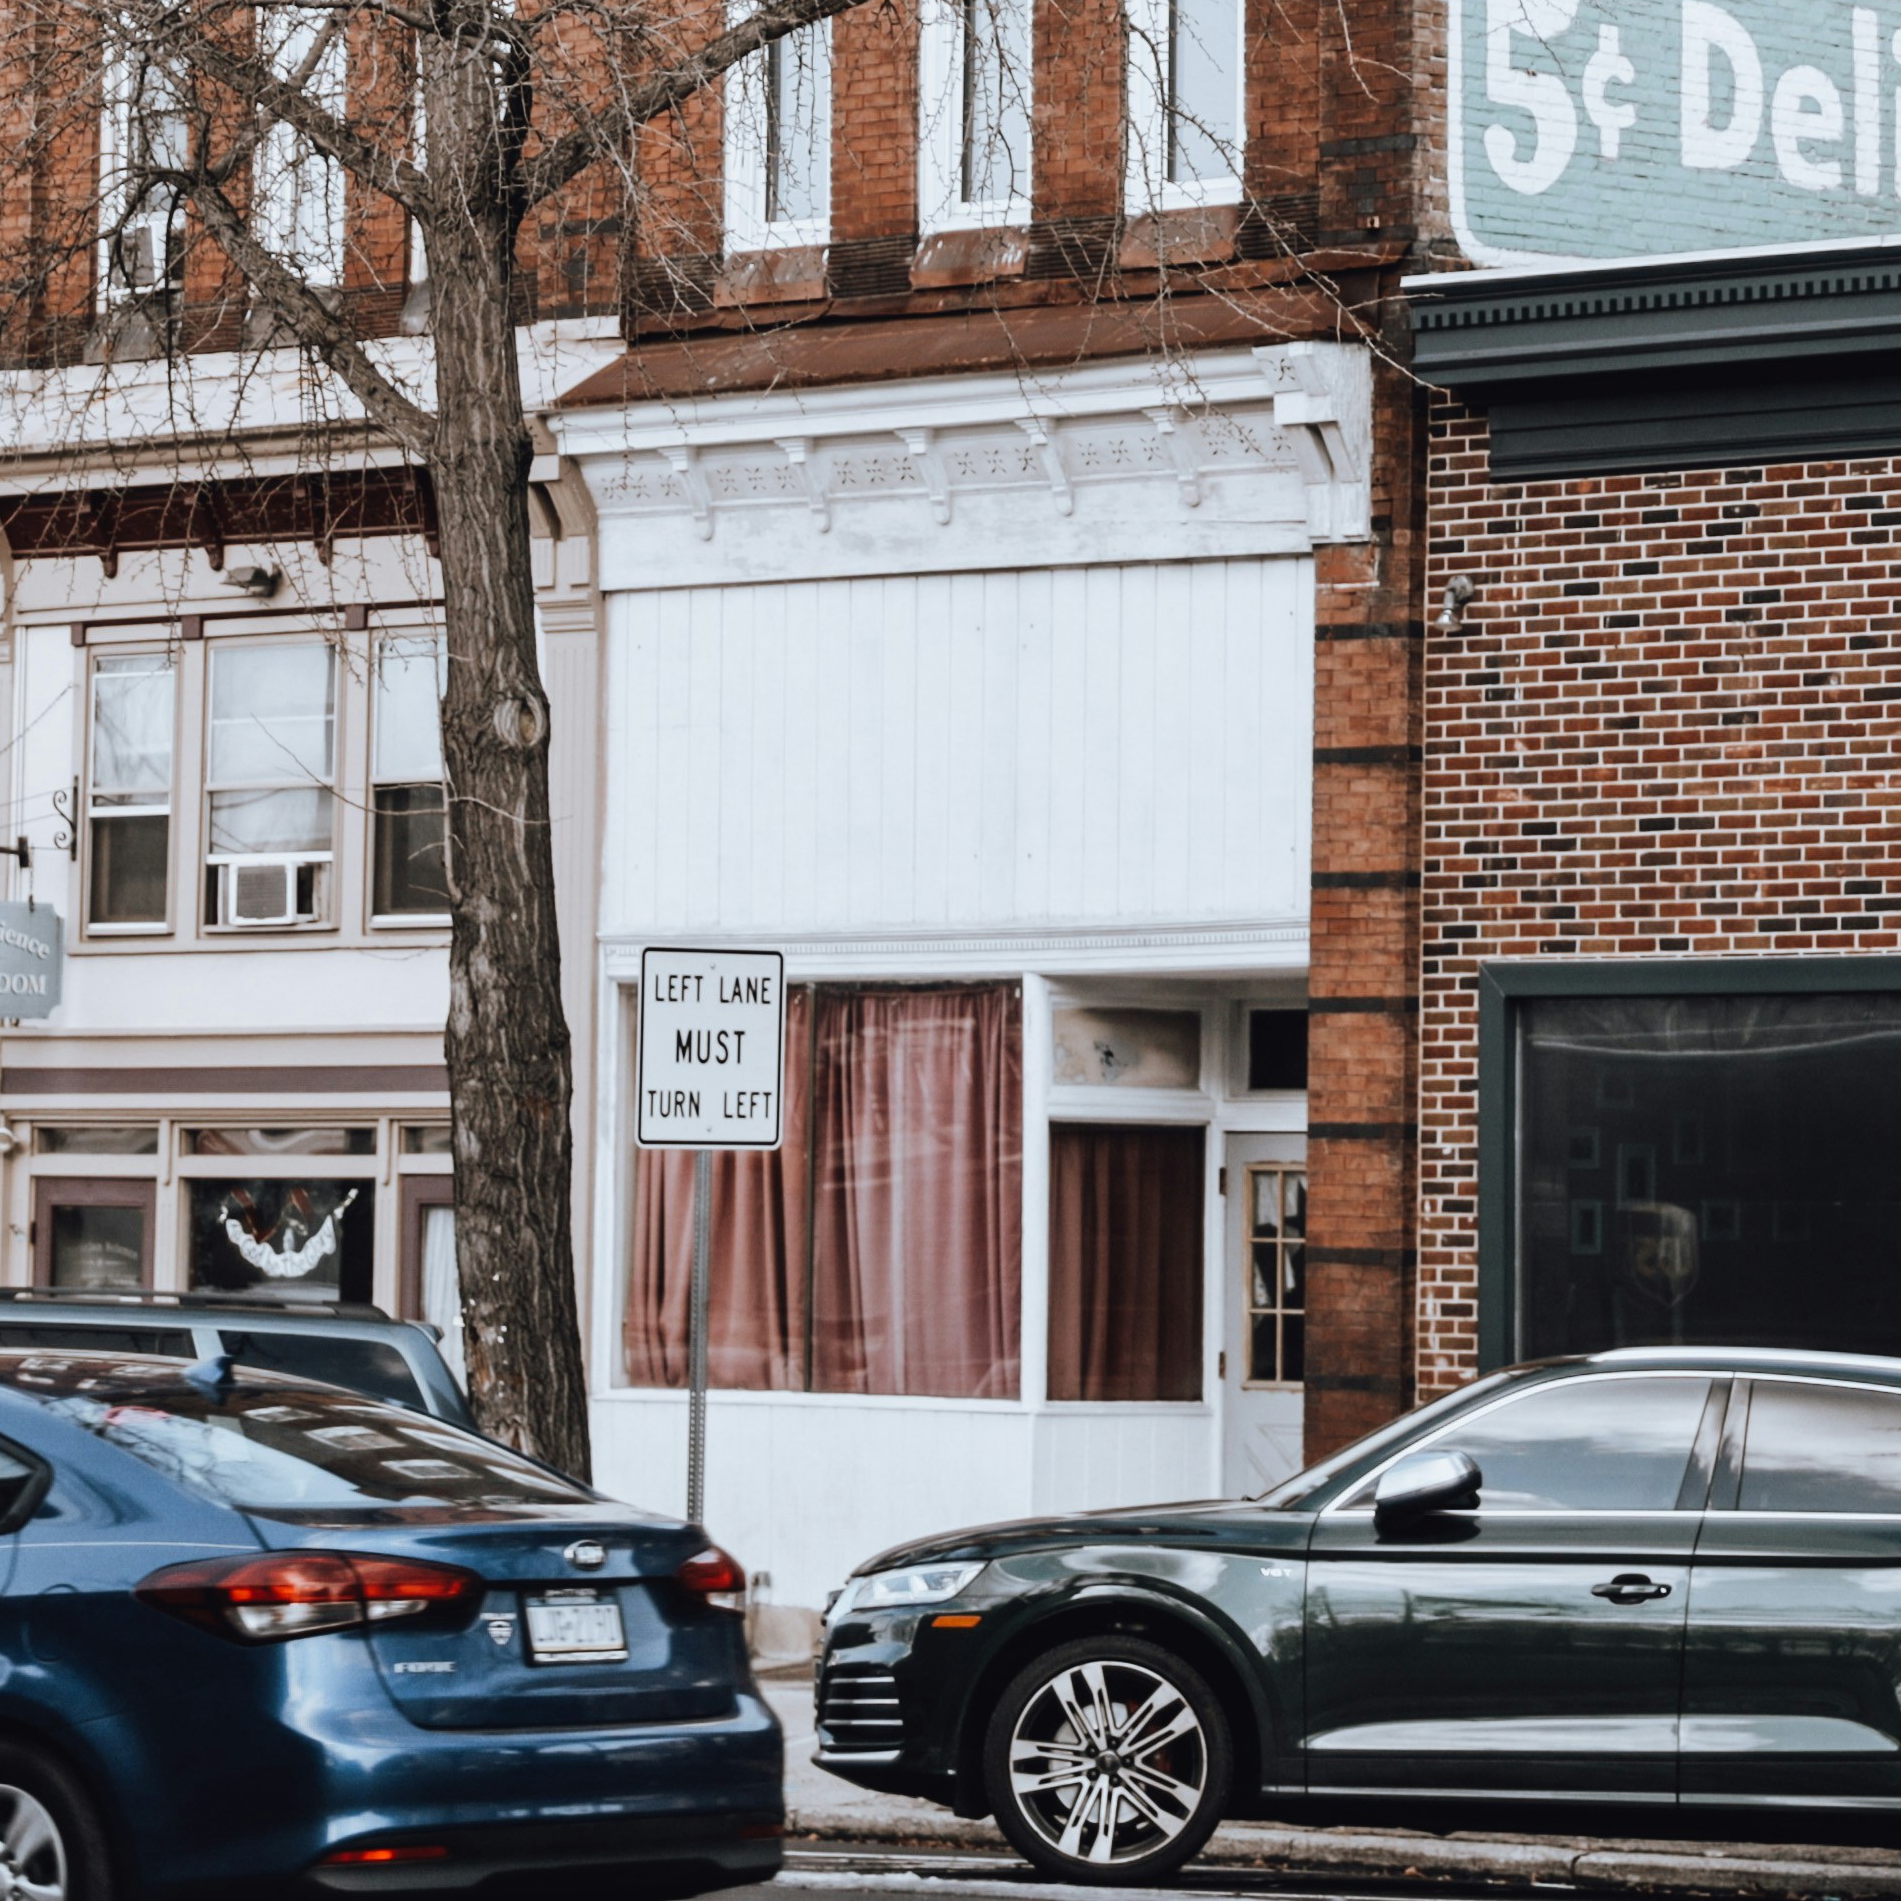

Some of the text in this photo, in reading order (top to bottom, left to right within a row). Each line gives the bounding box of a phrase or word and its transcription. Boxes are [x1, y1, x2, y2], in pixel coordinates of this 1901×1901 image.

[655, 974, 771, 1004] LEFT LANE
[675, 1029, 745, 1065] MUST
[648, 1090, 772, 1119] TURN LEFT
